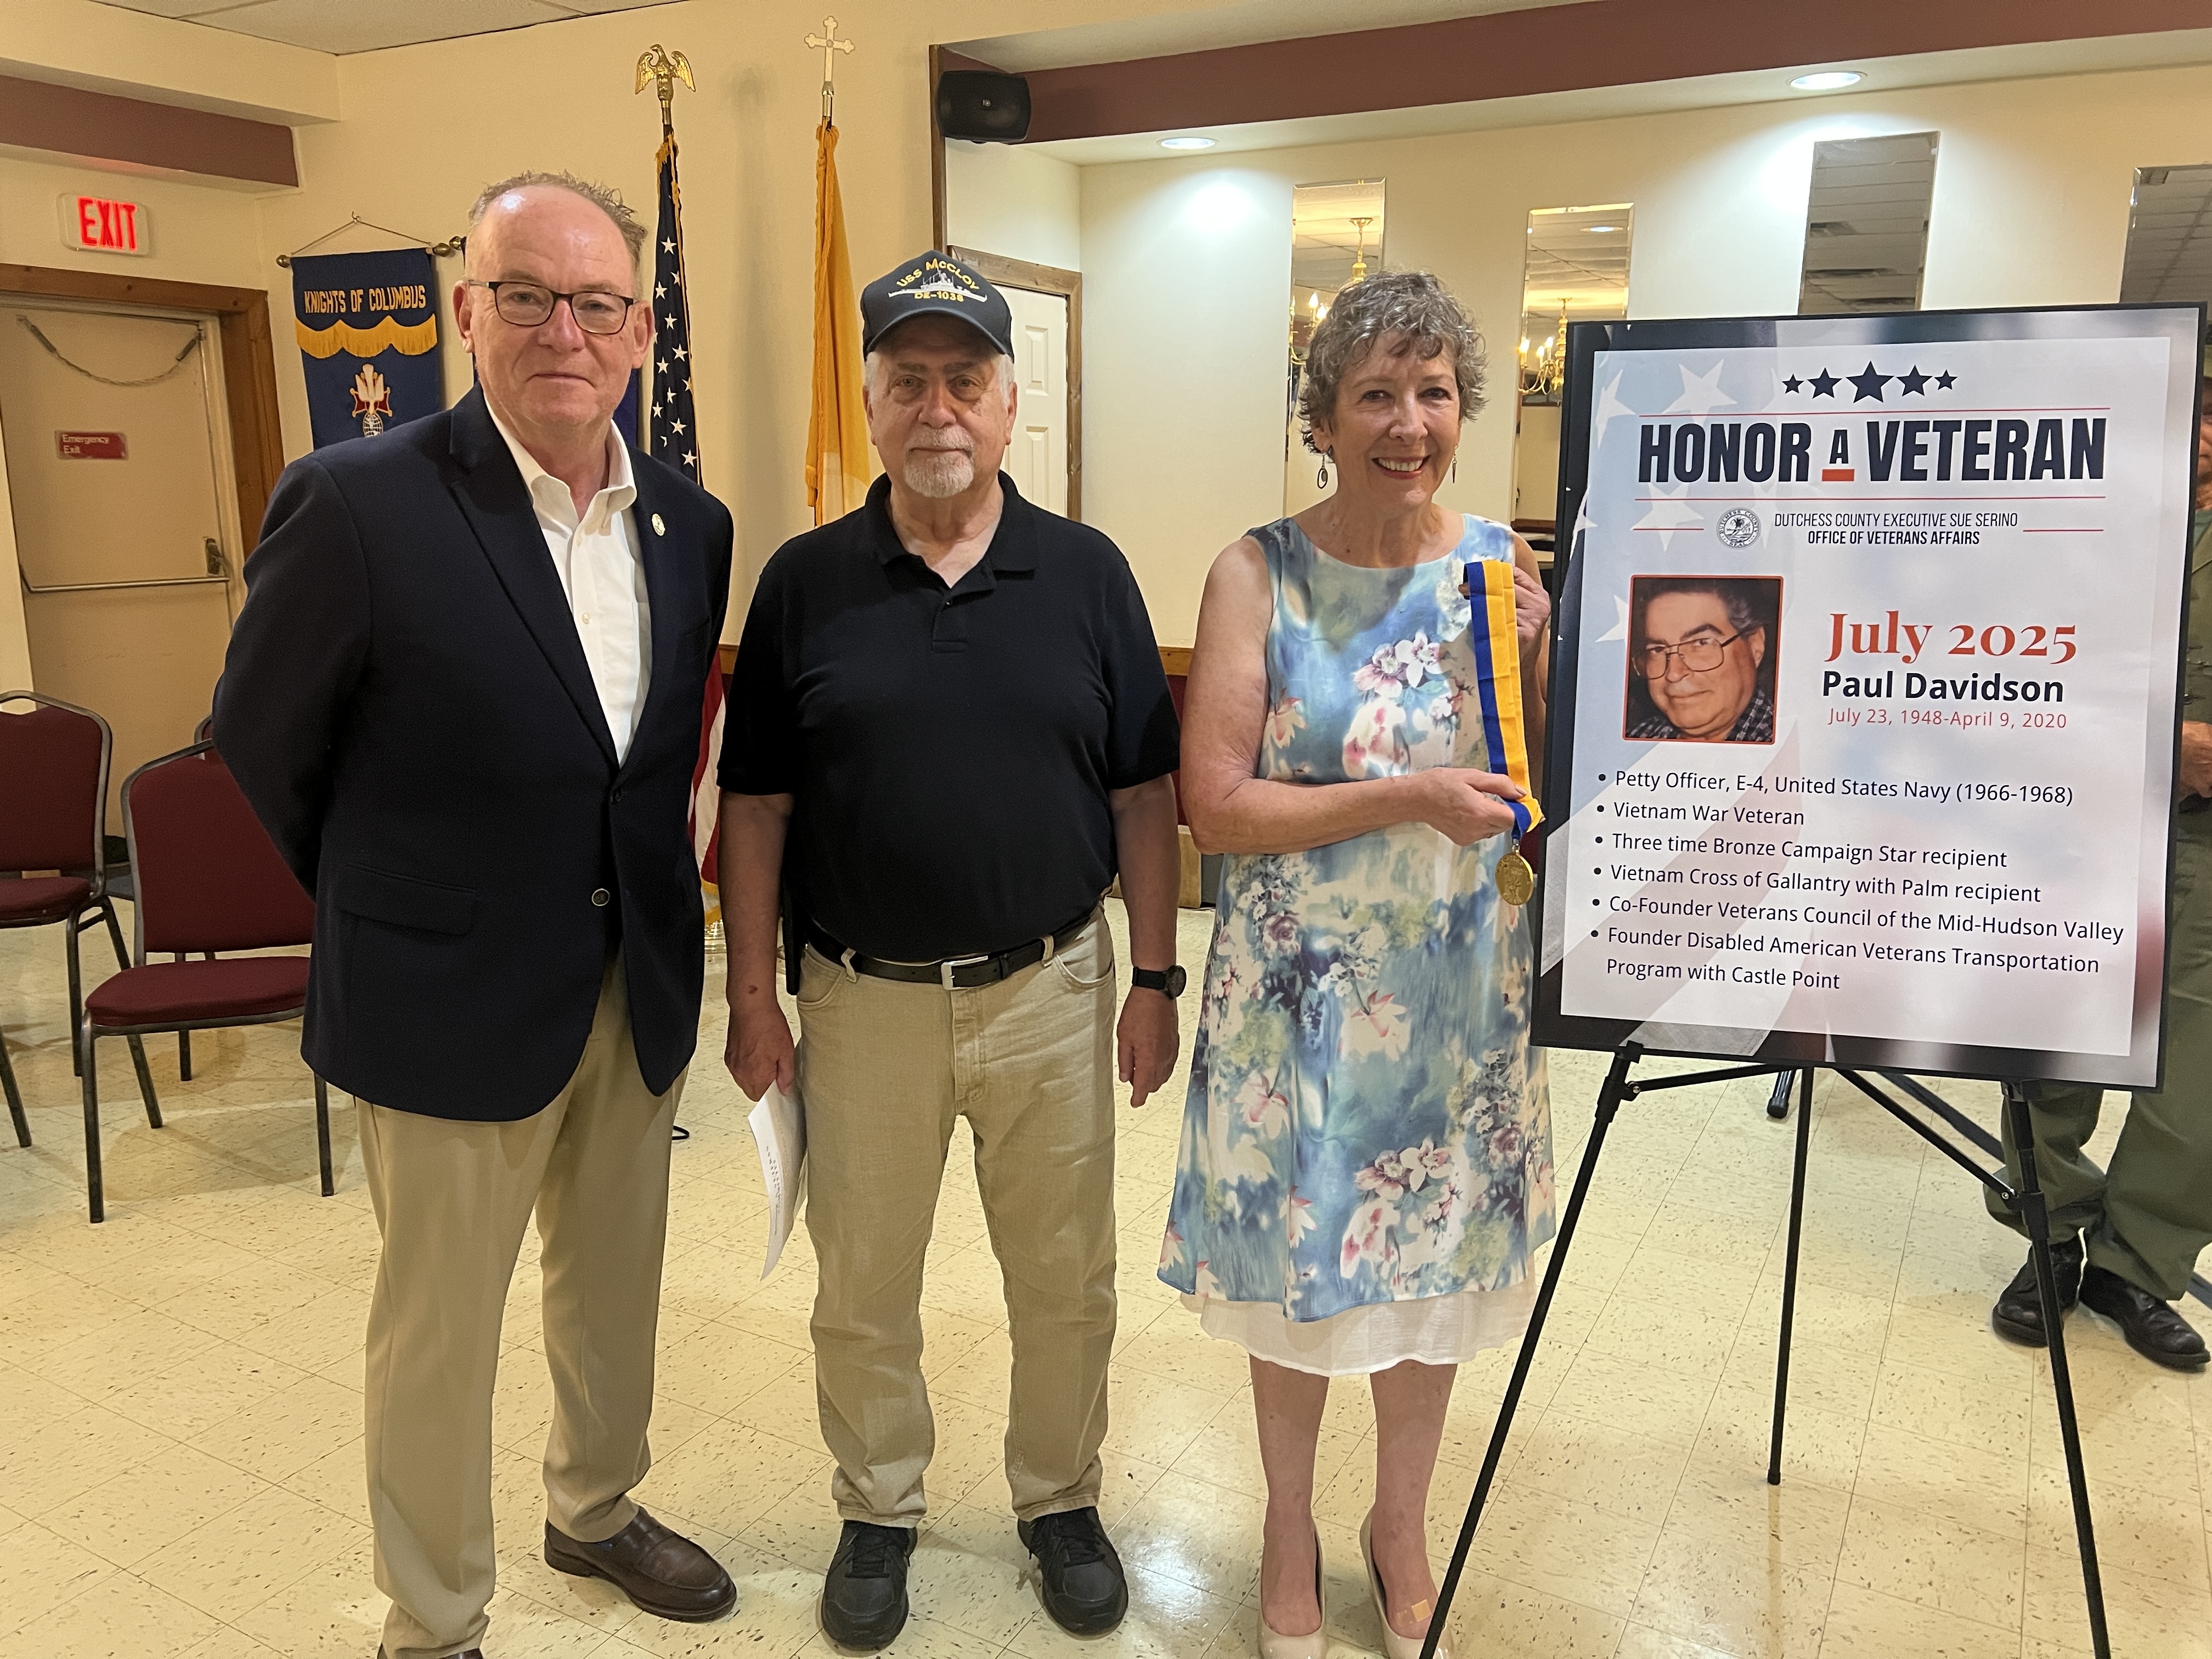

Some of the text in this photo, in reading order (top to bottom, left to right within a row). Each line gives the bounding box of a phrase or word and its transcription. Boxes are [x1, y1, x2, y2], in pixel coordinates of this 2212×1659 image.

[77, 196, 137, 251] EXIT
[896, 268, 922, 287] USS
[304, 285, 426, 313] KNIGHTS OF COLUMBUS
[914, 291, 964, 302] DE-1038
[61, 434, 109, 444] Emergency
[63, 445, 81, 454] Exit
[1638, 417, 2107, 483] HONOR A VETERAN
[1774, 512, 2018, 527] DUTCHESS COUNTY EXECUTIVE SUE SERINO
[1808, 531, 1980, 545] OFFICE OF VETERANS AFFAIRS
[1824, 610, 2076, 665] July 2025
[1822, 670, 2063, 702] Paul Davidson
[1827, 707, 2067, 730] July 23, 1948-April 9, 2020
[1616, 770, 2073, 807] Petty Officer, E-4, United States Navy (1966-1968)
[1613, 802, 1804, 825] Vietnam War Veteran
[1612, 832, 2007, 870] Three time Bronze Campaign Star recipient
[1611, 862, 2041, 905] Vietnam Cross of Gallantry with Palm recipient
[1610, 895, 2124, 945] Co-Founder Veterans Council of the Mid-Hudson Valley
[1609, 927, 2098, 973] Founder Disabled American Veterans Transportation
[1607, 958, 1840, 989] Program with Castle Point
